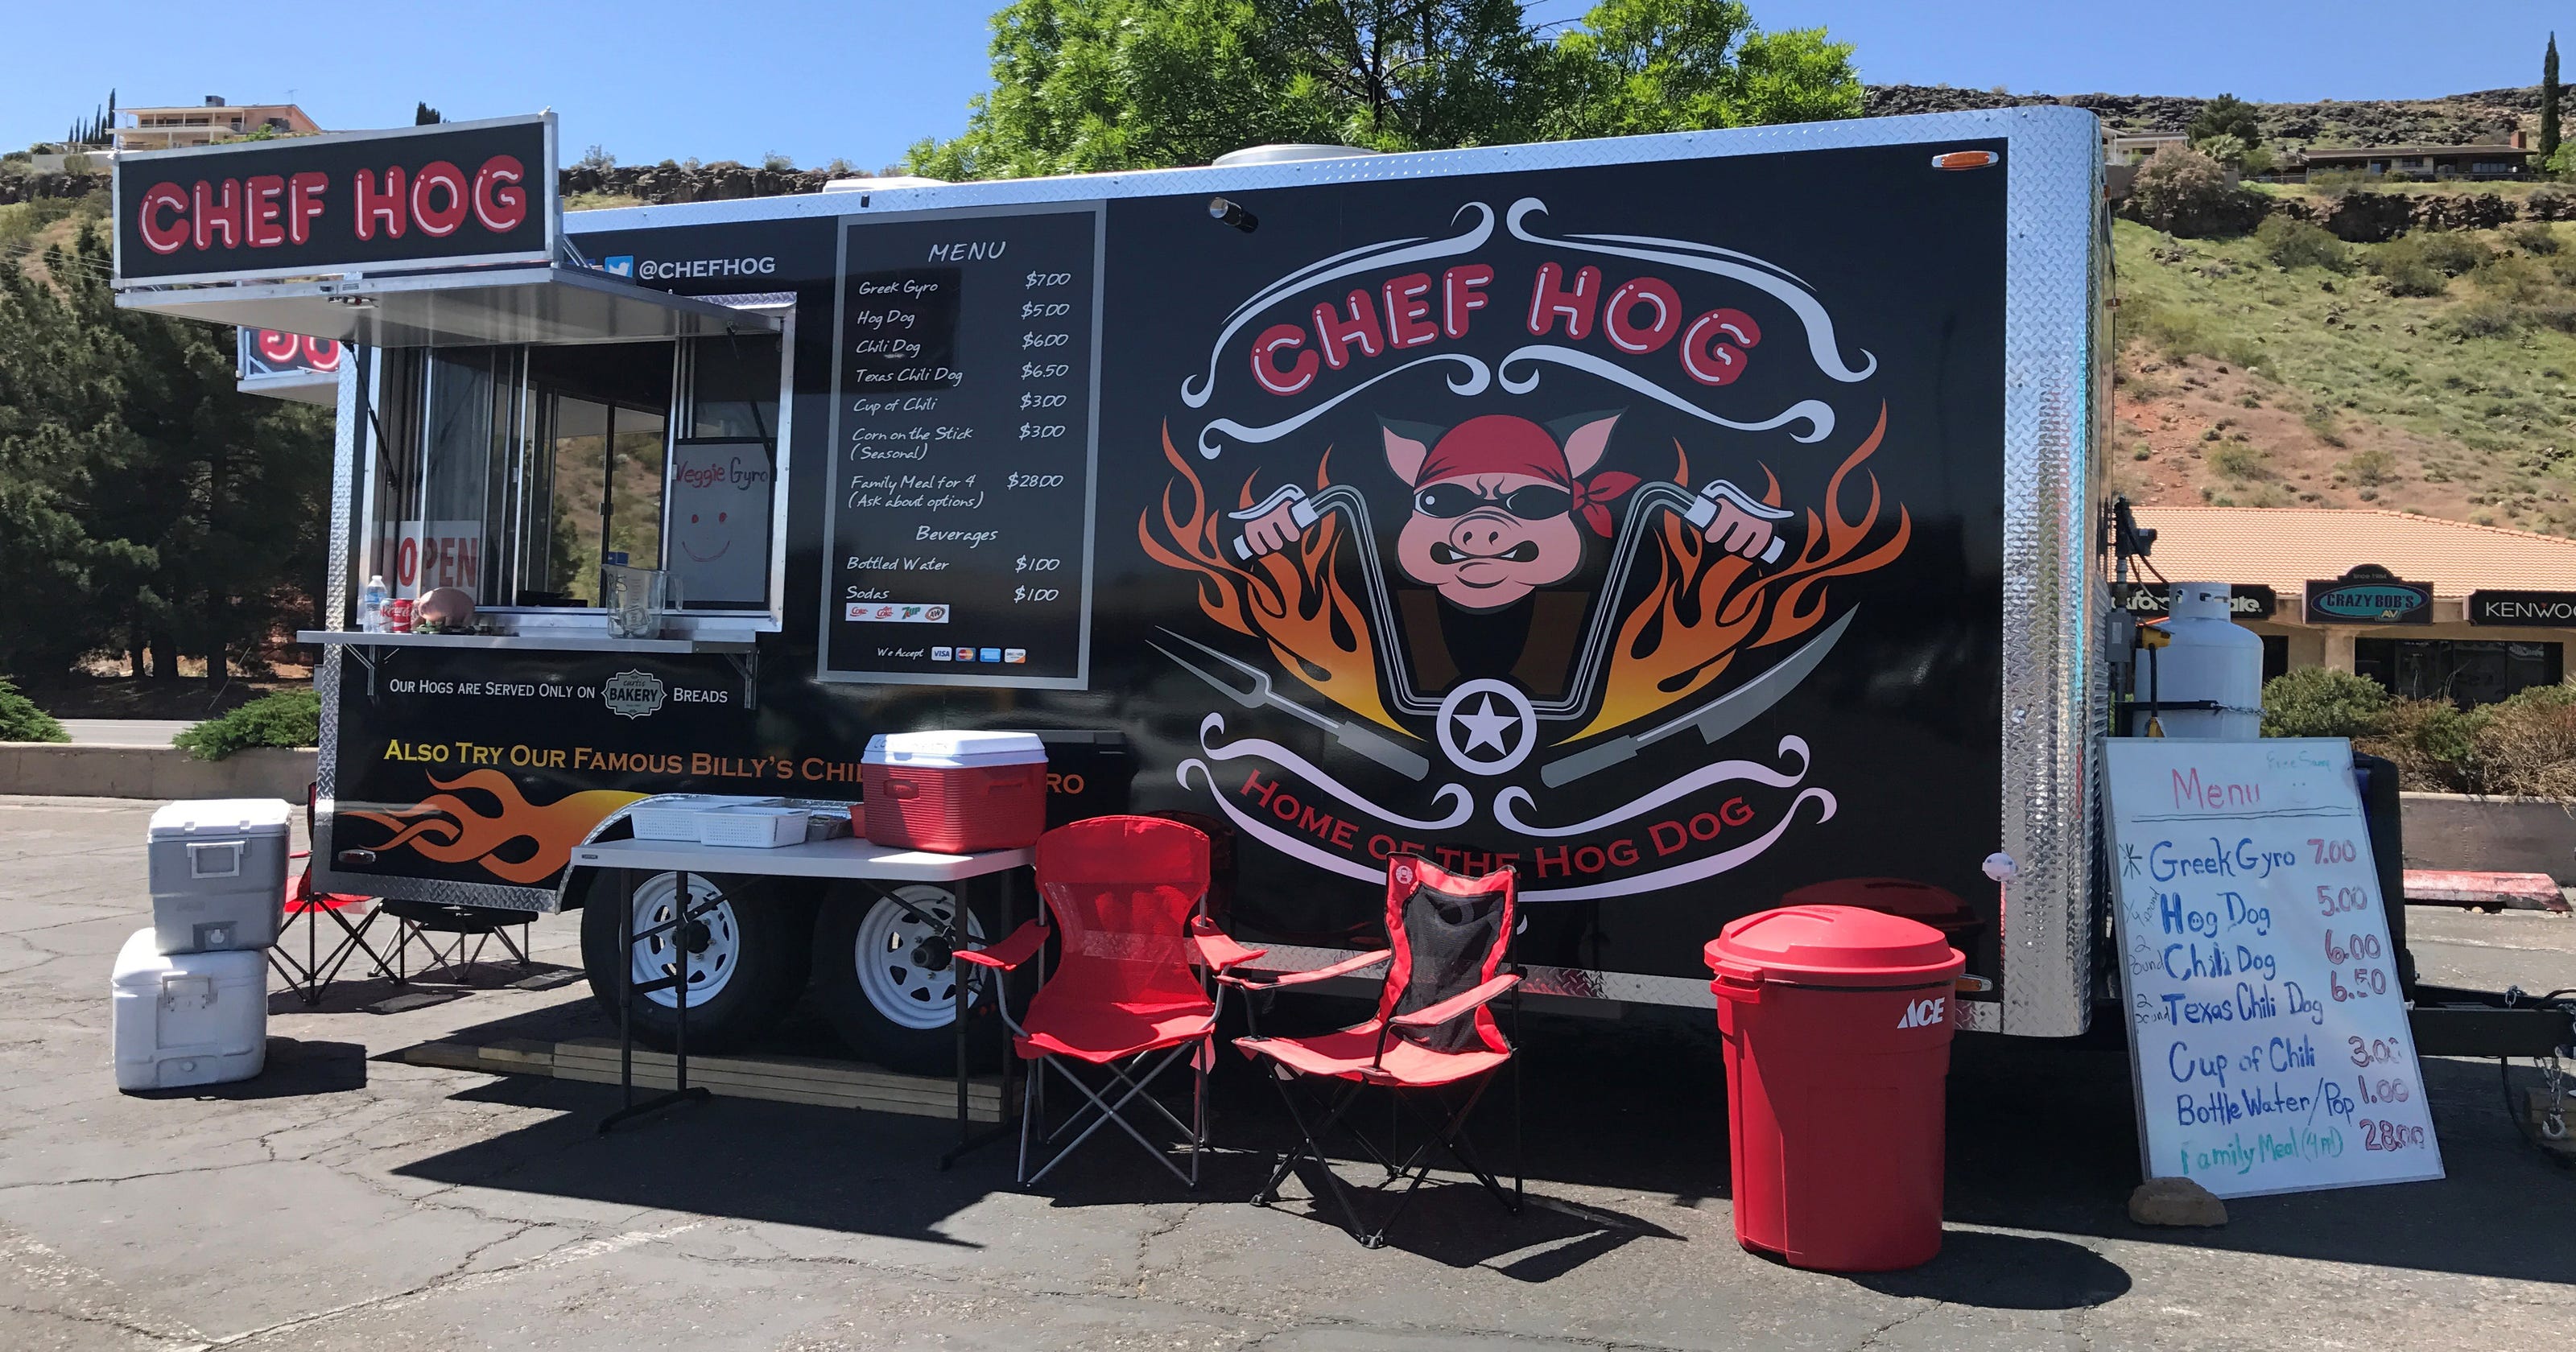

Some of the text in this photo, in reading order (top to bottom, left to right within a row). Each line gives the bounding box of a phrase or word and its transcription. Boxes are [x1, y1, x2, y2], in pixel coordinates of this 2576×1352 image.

[138, 155, 526, 254] CHEF HOG
[928, 241, 1006, 262] MENU
[638, 257, 776, 280] @CHEFHOG
[858, 281, 899, 295] Greek
[902, 279, 939, 299] Gyro
[857, 310, 882, 330] Hog
[886, 309, 916, 329] Dog
[1250, 262, 1761, 396] CHEF HOG
[856, 340, 889, 354] Chili
[891, 339, 921, 359] Dog
[856, 361, 1069, 387] Texas Chili Dog $6.50
[853, 398, 881, 416] Cup
[885, 398, 901, 411] of
[903, 397, 939, 411] Chili
[852, 427, 886, 441] Corn
[890, 432, 906, 440] on
[908, 427, 931, 440] the
[935, 427, 974, 440] Stick
[850, 443, 928, 461] (Seasonal)
[675, 457, 769, 491] Veggie Gyro
[851, 475, 898, 496] Family
[900, 474, 935, 489] Meal
[937, 476, 961, 489] for
[964, 474, 976, 488] 4
[848, 491, 985, 513] (Ask about options)
[916, 525, 998, 548] Beverages
[398, 536, 478, 587] OPEN
[846, 556, 897, 571] Bottled
[902, 557, 950, 571] Water
[846, 586, 890, 600] Sodas
[2326, 594, 2414, 608] CRAZY BOB'S
[2380, 609, 2399, 619] AV
[2486, 601, 2576, 619] KENWO
[877, 647, 925, 660] We Accept
[390, 678, 596, 699] OUR HOGS ARE SERVED ONLY ON
[609, 687, 658, 702] BAKERY
[673, 687, 729, 703] BREADS
[384, 739, 450, 763] ALSO
[456, 741, 505, 765] TRY
[509, 744, 566, 769] OUR
[574, 747, 683, 774] FAMOUS
[691, 752, 793, 779] BILLY'S
[2172, 767, 2260, 810] Menu
[1239, 769, 1360, 851] HOME
[1534, 839, 1641, 878] HOG
[1648, 796, 1756, 856] DOG
[2150, 837, 2356, 882] Greek Gyro 7.00
[2161, 885, 2368, 938] Hog Dog 5.00
[2134, 934, 2151, 952] 2
[2164, 929, 2381, 981] Chili Dog 6.00
[2136, 993, 2153, 1008] 2
[2161, 968, 2386, 1026] Texas Chili Dog 6.50
[1897, 997, 1946, 1029] ACE
[2169, 1041, 2228, 1088] Cup
[2239, 1045, 2263, 1072] of
[2269, 1033, 2316, 1072] Chili
[2177, 1091, 2242, 1126] Bottle
[2358, 1074, 2409, 1103] 1.00
[2181, 1132, 2255, 1175] Family
[2259, 1126, 2299, 1163] Meal
[2359, 1119, 2425, 1152] 28.00
